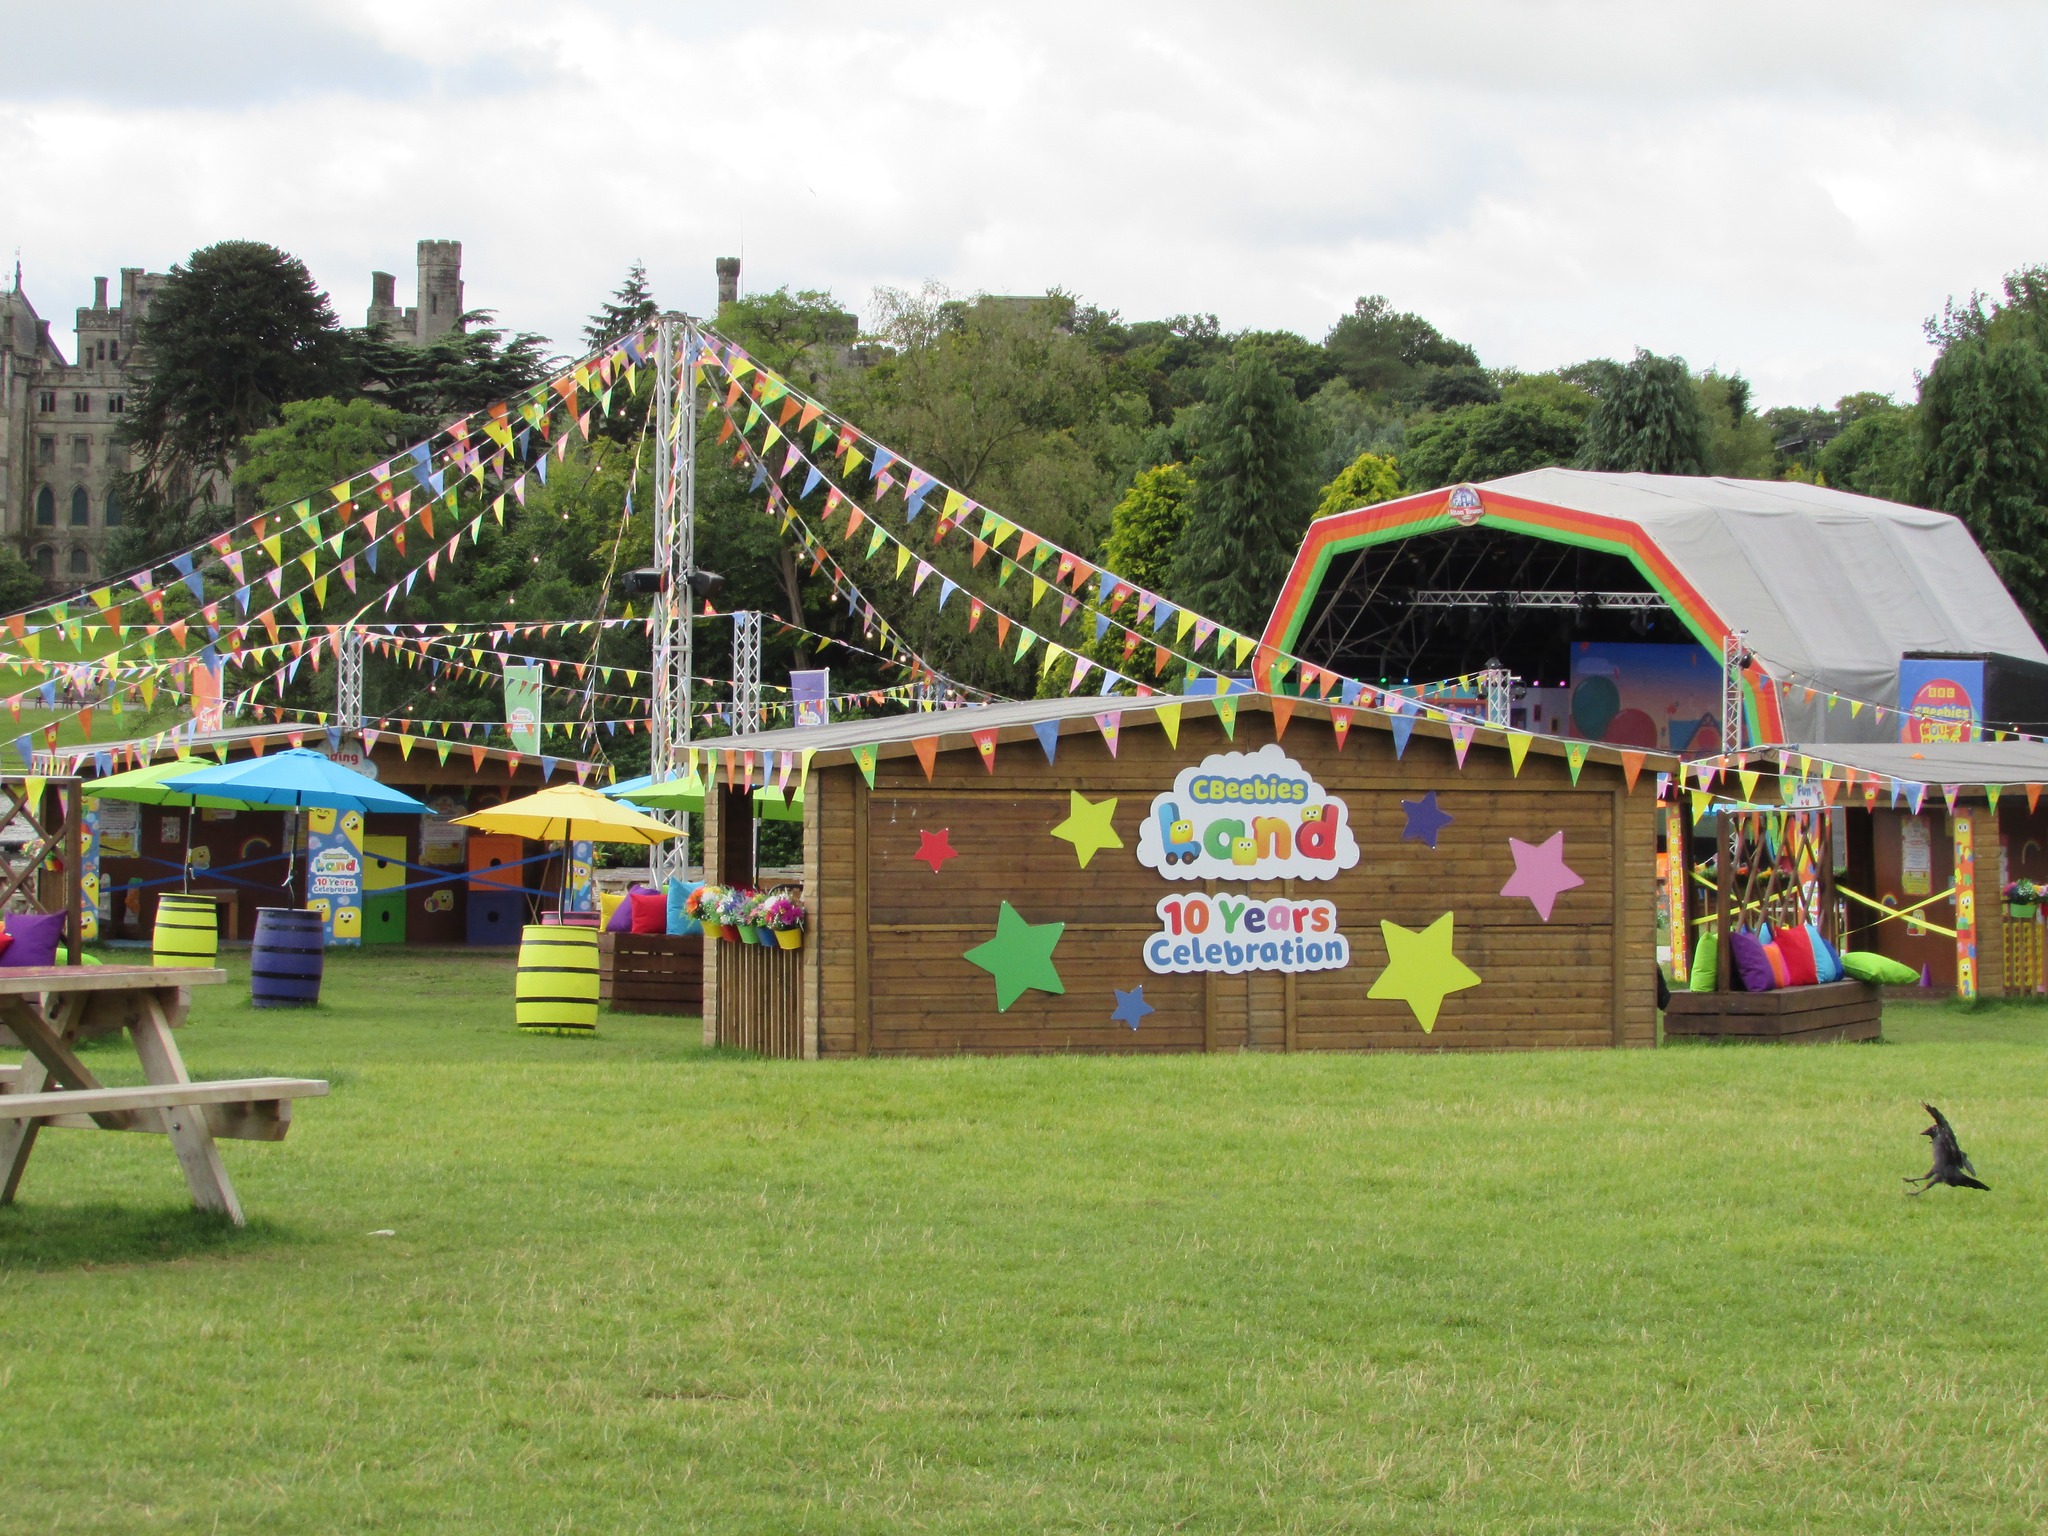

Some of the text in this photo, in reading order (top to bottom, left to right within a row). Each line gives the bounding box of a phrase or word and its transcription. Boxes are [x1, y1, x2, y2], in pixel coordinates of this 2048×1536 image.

[1913, 705, 1970, 719] CBeebies
[1192, 777, 1306, 802] CBeebies
[1157, 802, 1340, 866] Land
[315, 858, 356, 872] Land
[316, 877, 355, 886] 10 Years
[1163, 899, 1330, 936] 10 Years
[1149, 936, 1343, 967] Celebration
